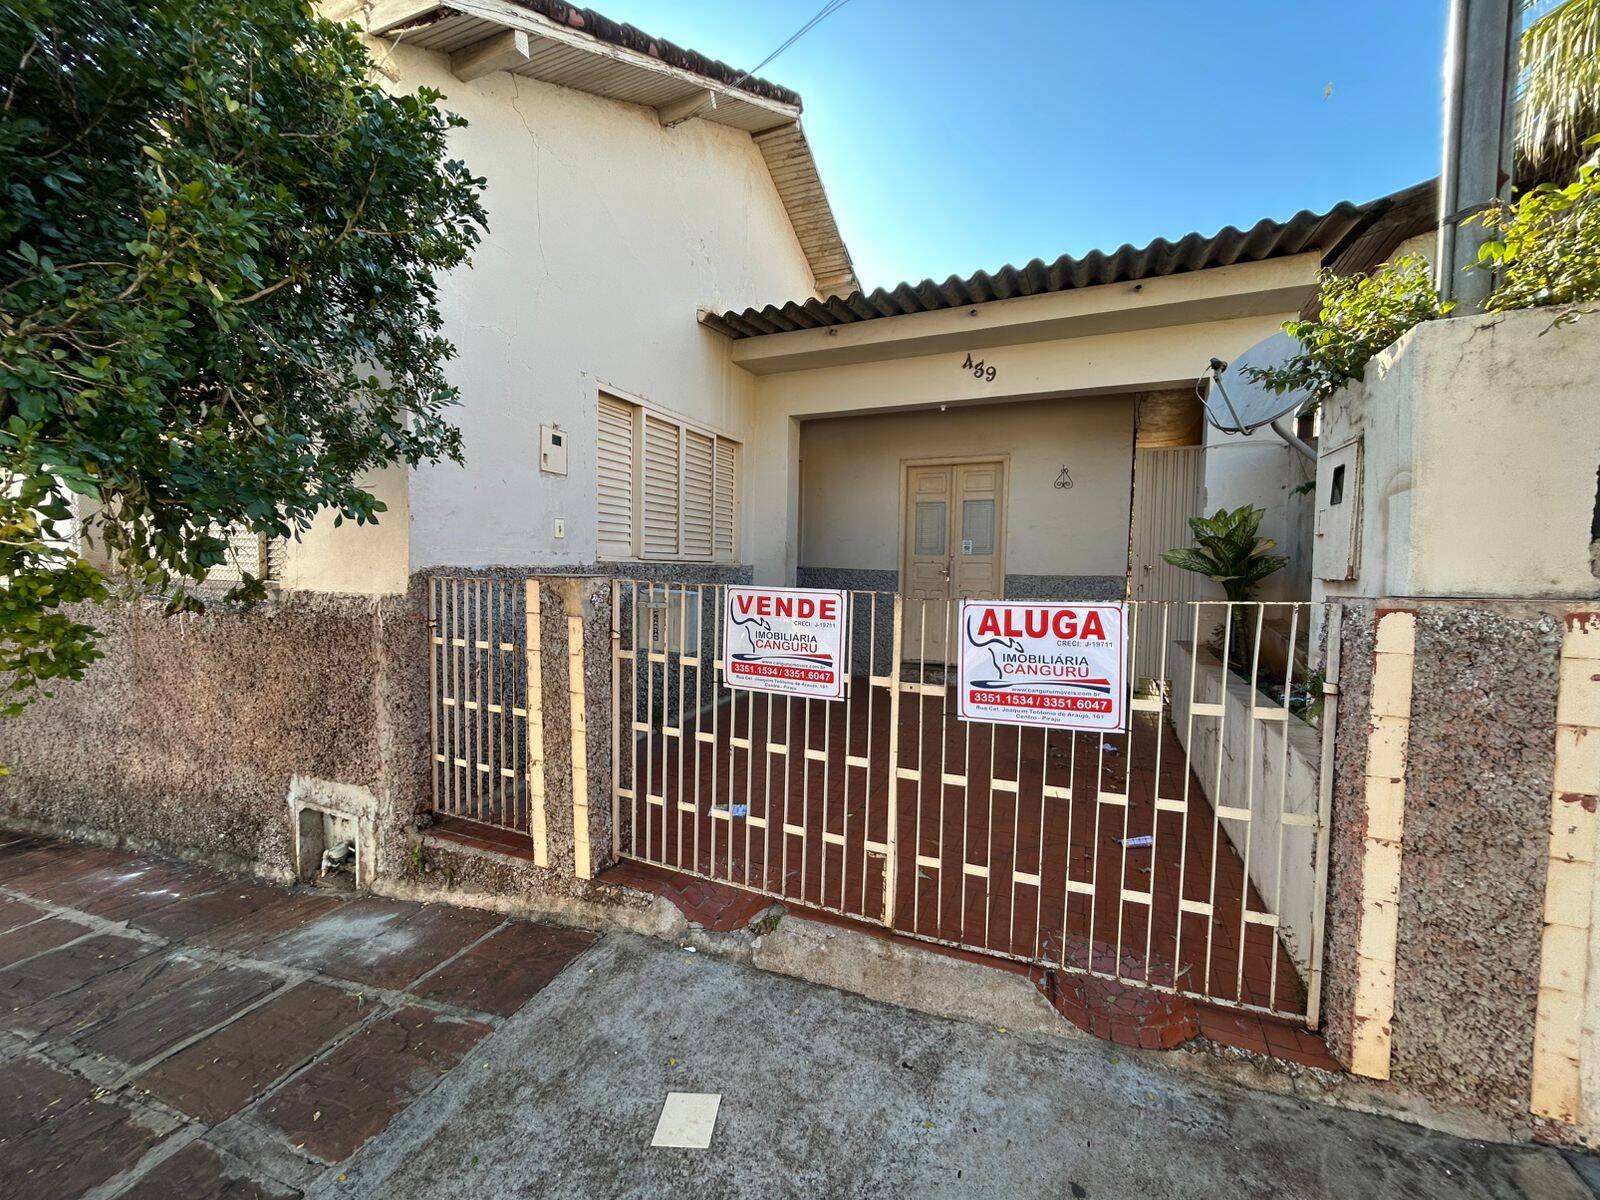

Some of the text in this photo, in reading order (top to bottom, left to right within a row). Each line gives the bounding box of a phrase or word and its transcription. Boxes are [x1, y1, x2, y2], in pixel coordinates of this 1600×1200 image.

[736, 594, 837, 620] VENDE
[814, 621, 836, 629] J-19711
[977, 608, 1107, 641] ALUGA
[755, 630, 818, 643] IMOBILIÁRIA
[755, 639, 818, 653] CANGURU
[1056, 640, 1081, 648] CRECI:
[1002, 653, 1089, 666] IMOBILIÁRIA
[734, 663, 778, 676] 3351.1534
[783, 668, 831, 681] 3351.6047
[1003, 664, 1089, 678] CANGURU
[974, 692, 1034, 706] 3351.1534
[1043, 697, 1108, 711] 3351.6047
